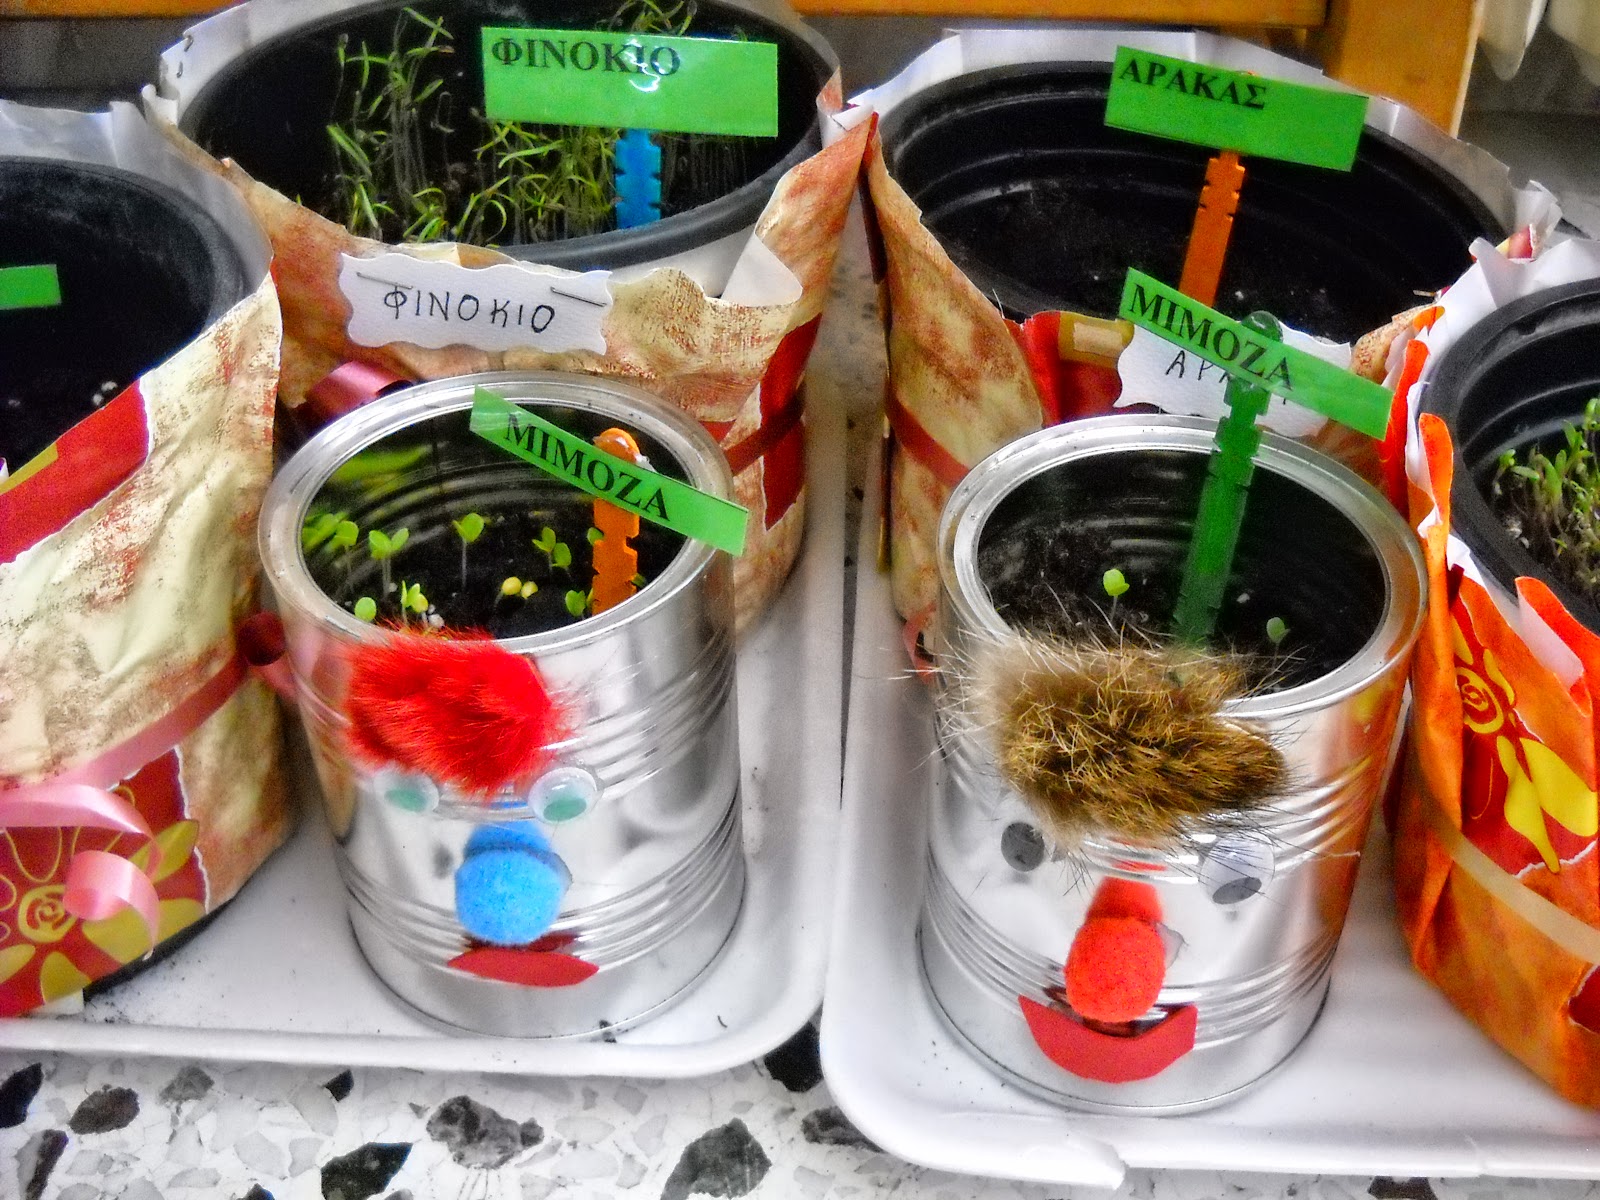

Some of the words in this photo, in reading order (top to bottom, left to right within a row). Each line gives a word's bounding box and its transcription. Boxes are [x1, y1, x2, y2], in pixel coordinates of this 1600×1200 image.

[491, 37, 681, 76] ΦΙΝΟΚΙΟ
[1119, 58, 1267, 110] ΑΡΑΚΑΣ
[383, 284, 555, 333] ΦΙΝΟΚΙΟ
[1128, 283, 1294, 392] ΜΙΜΟΖΑ
[503, 413, 672, 521] ΜΙΜΟΖΑ
